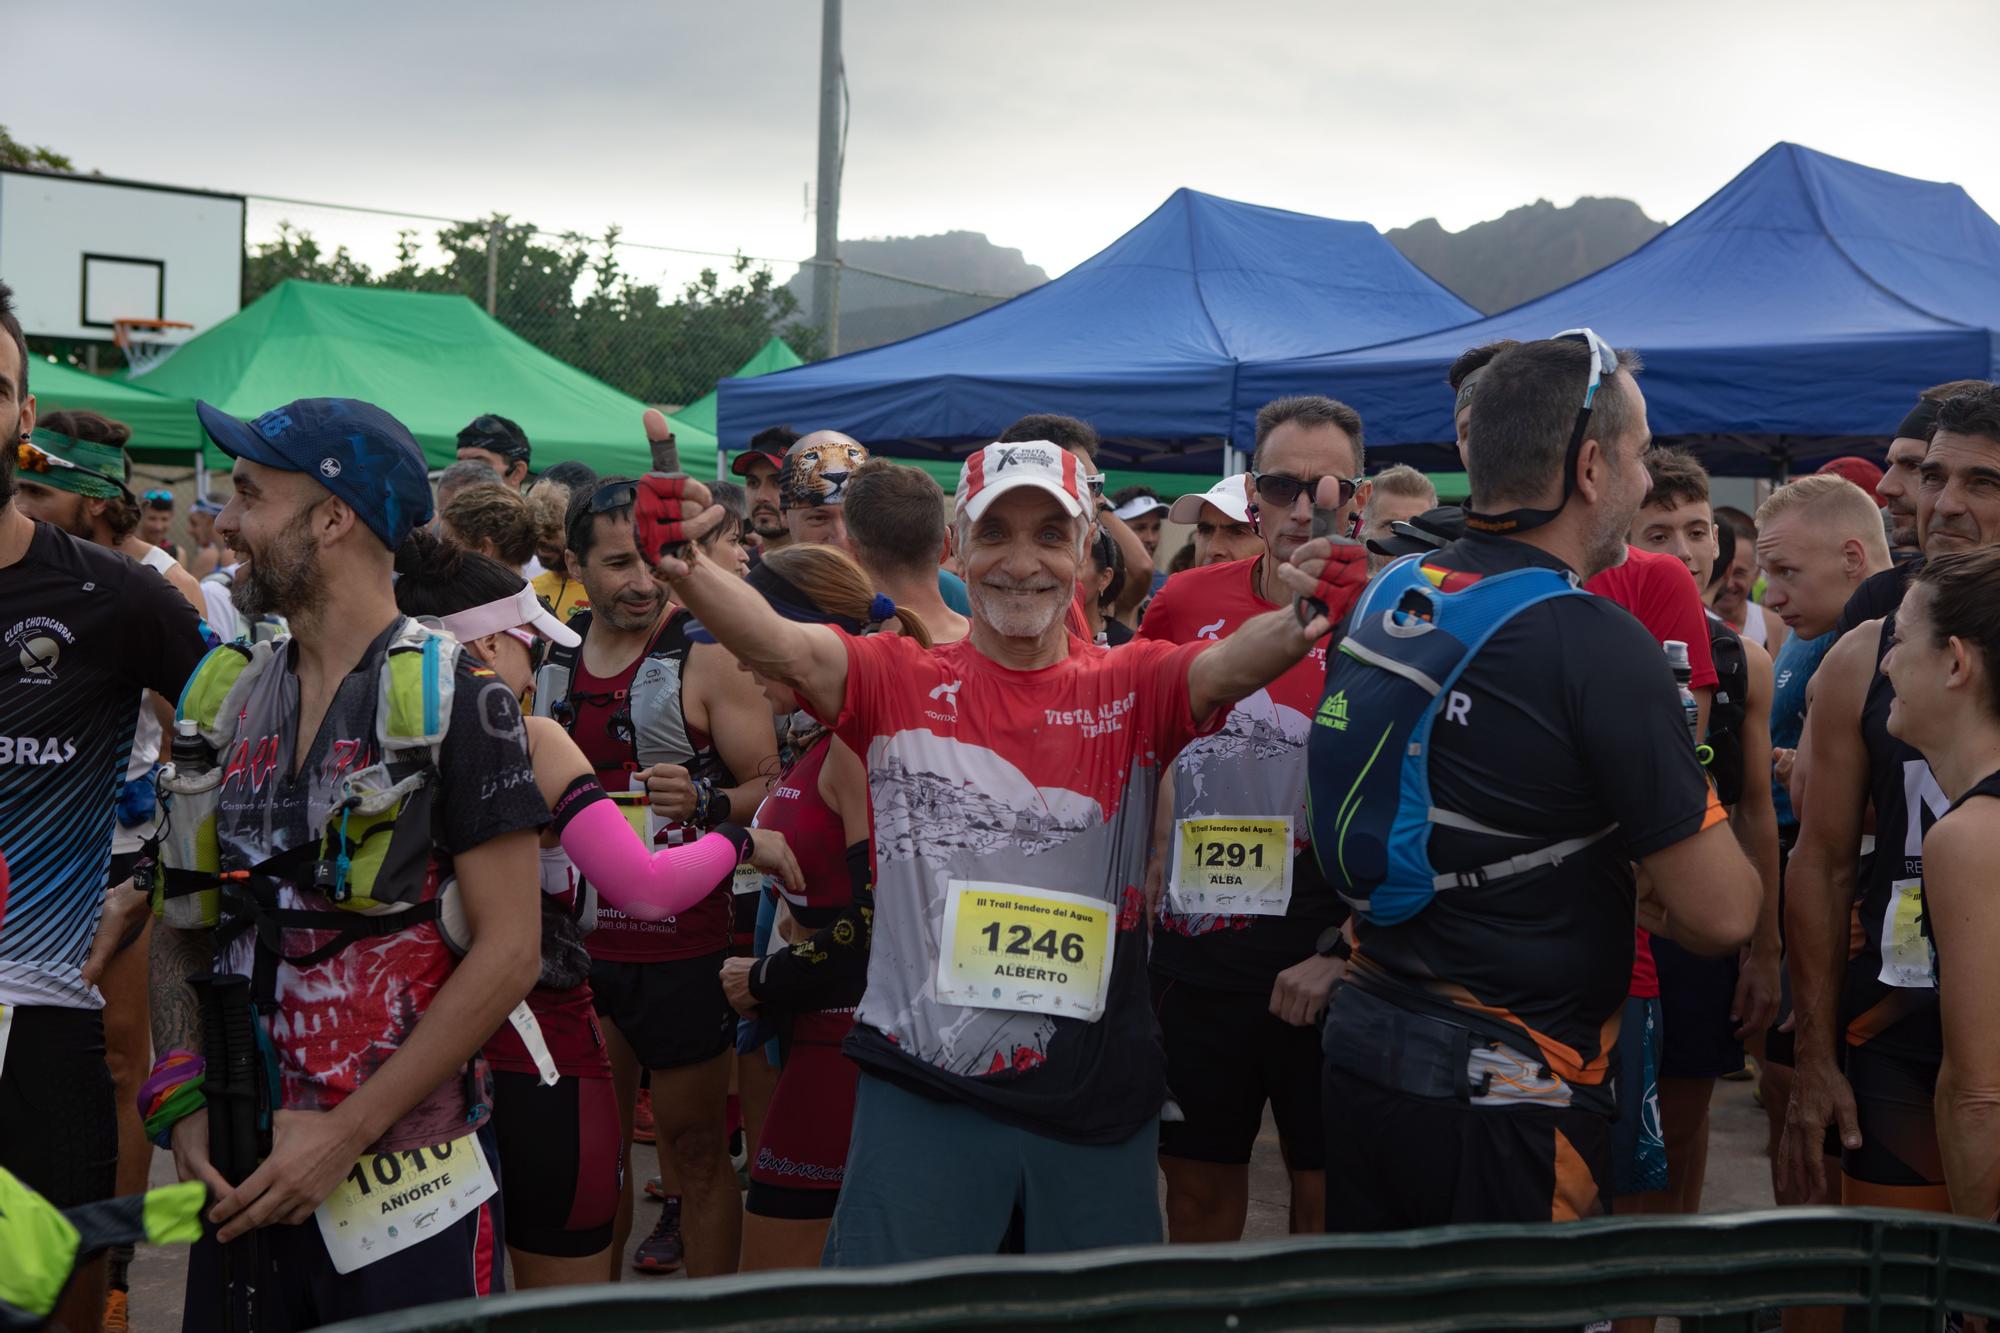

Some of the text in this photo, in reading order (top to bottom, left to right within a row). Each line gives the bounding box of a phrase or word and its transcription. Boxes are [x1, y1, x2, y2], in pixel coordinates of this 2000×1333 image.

[4, 616, 76, 645] CLUB CHOTACABRAS
[1044, 708, 1094, 726] VISTA
[1081, 718, 1122, 738] TRAIL
[0, 736, 77, 765] BRAS
[1195, 842, 1264, 868] 1291
[1210, 875, 1243, 885] ALBA
[597, 907, 626, 919] entro
[977, 898, 1093, 923] III Trail Sendero del Agua
[640, 922, 677, 934] Caridad
[982, 921, 1085, 964] 1246
[994, 964, 1068, 984] ALBERTO
[381, 1172, 452, 1215] ANIORTE
